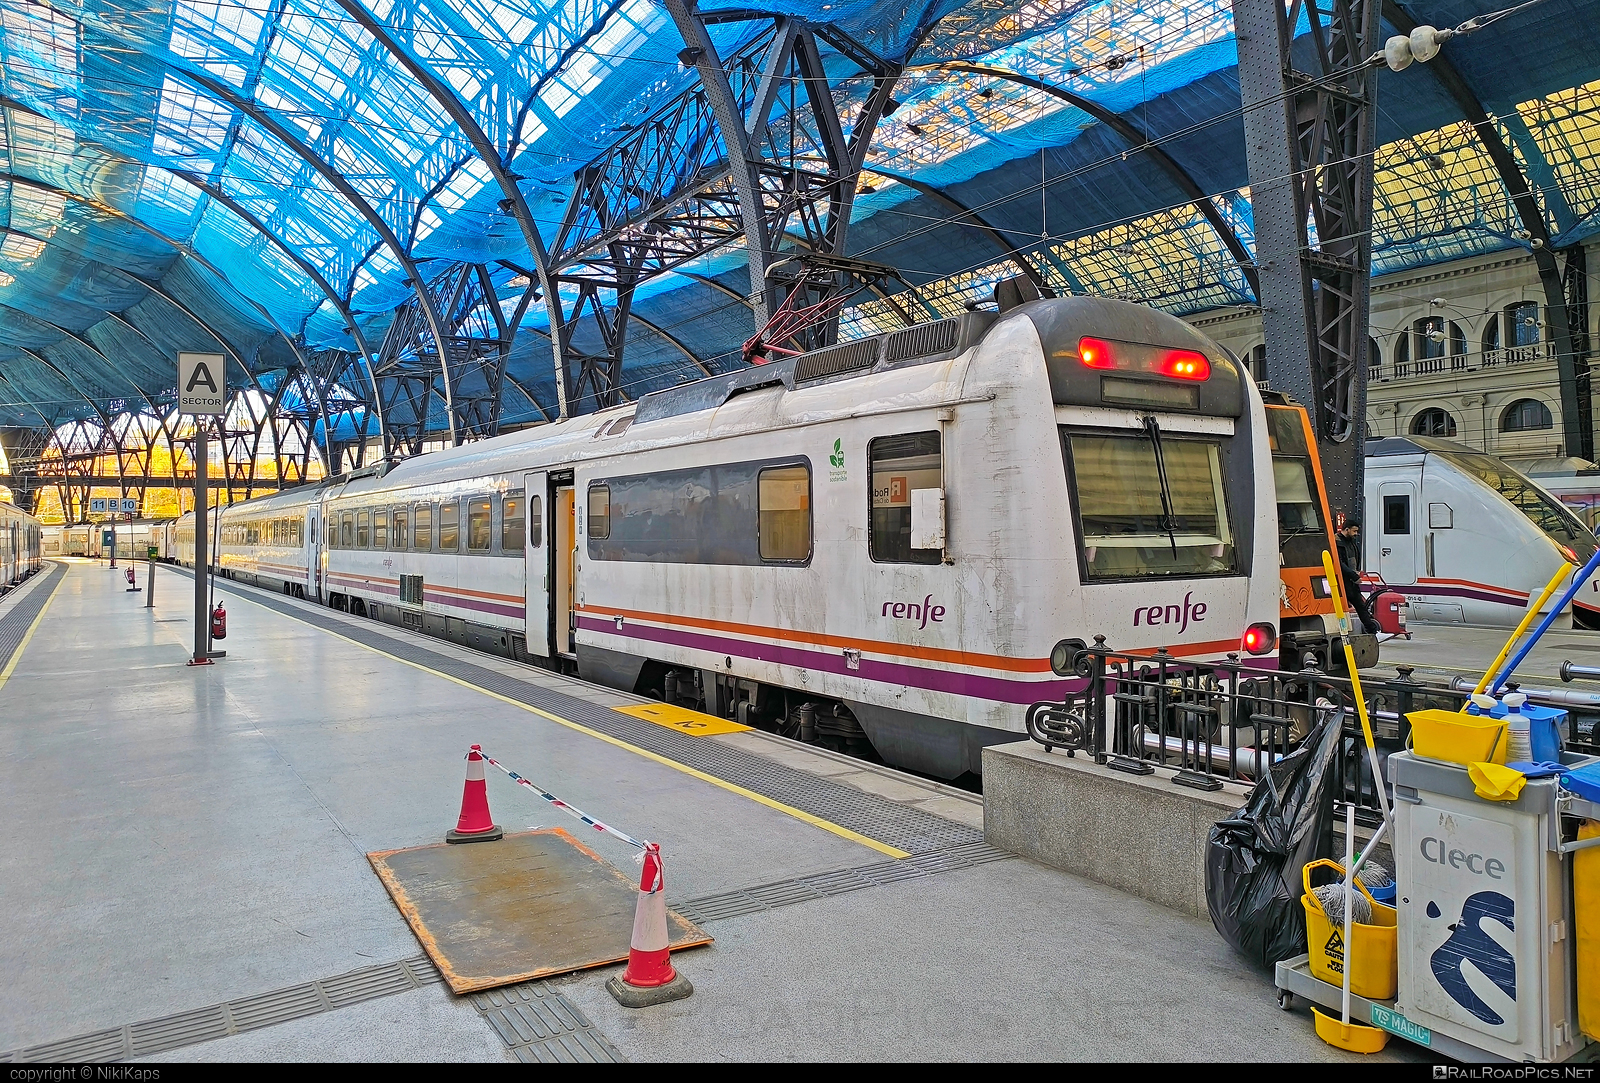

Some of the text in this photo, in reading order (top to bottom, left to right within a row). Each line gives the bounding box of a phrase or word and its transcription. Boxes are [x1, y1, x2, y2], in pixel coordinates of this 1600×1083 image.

[186, 362, 217, 393] A
[182, 397, 221, 406] SECTOR
[92, 500, 135, 509] 11 B 10
[882, 593, 946, 630] renfe
[1133, 591, 1207, 635] renfe
[1420, 836, 1506, 880] Clece
[1391, 1014, 1425, 1040] MAGIC
